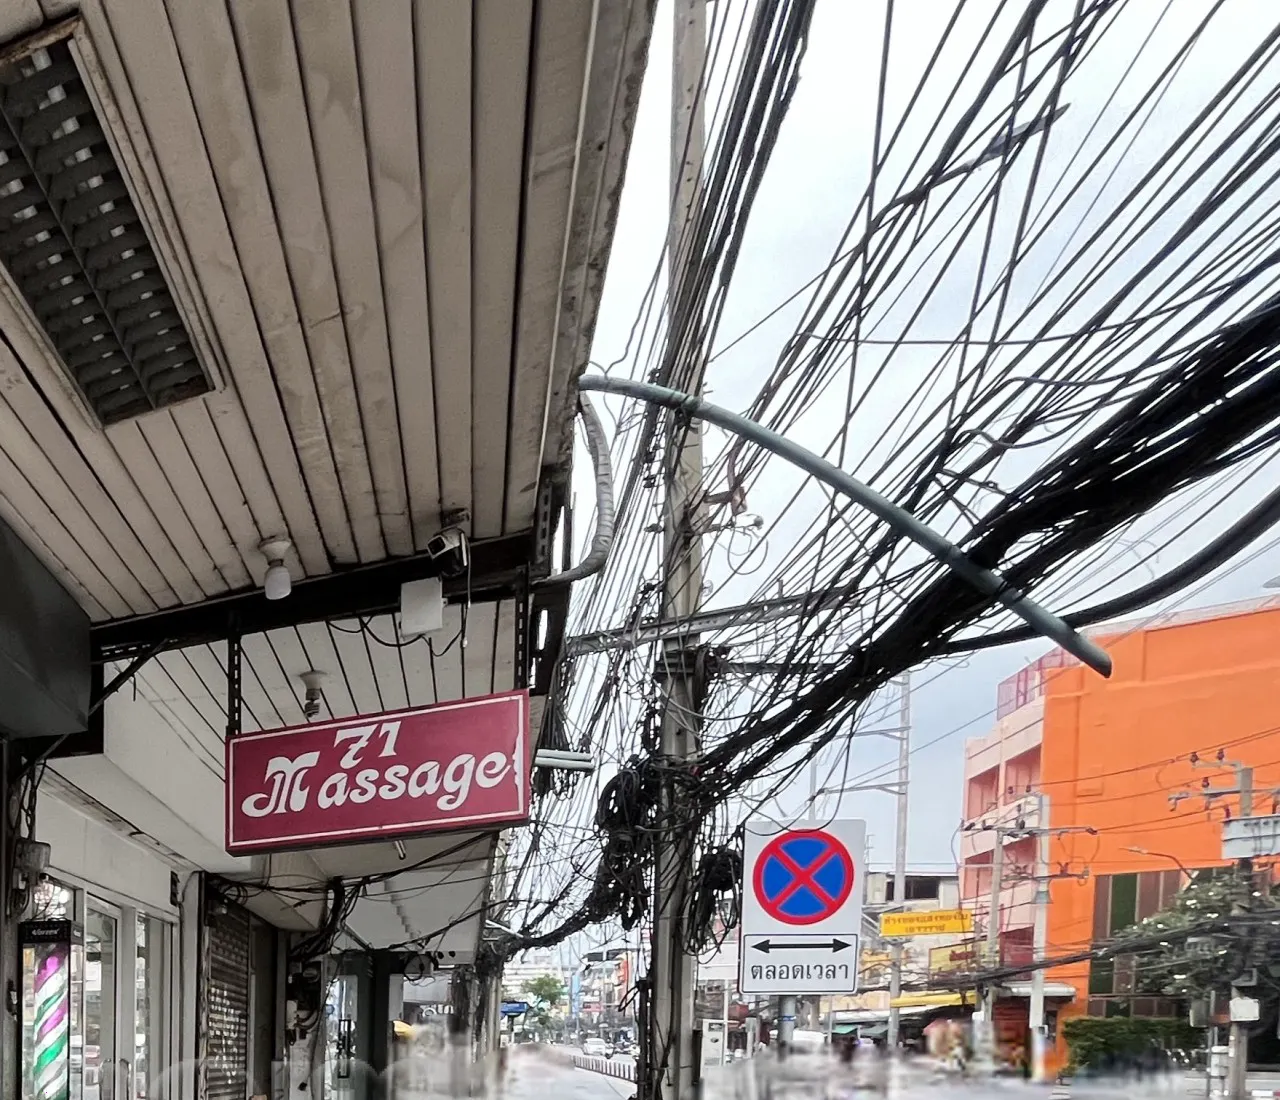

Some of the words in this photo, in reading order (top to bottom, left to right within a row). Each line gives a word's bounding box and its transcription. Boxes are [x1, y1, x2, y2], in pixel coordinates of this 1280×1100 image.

[333, 720, 402, 769] 71
[241, 750, 511, 817] Massage
[750, 961, 850, 981] ตลอดเวลา
